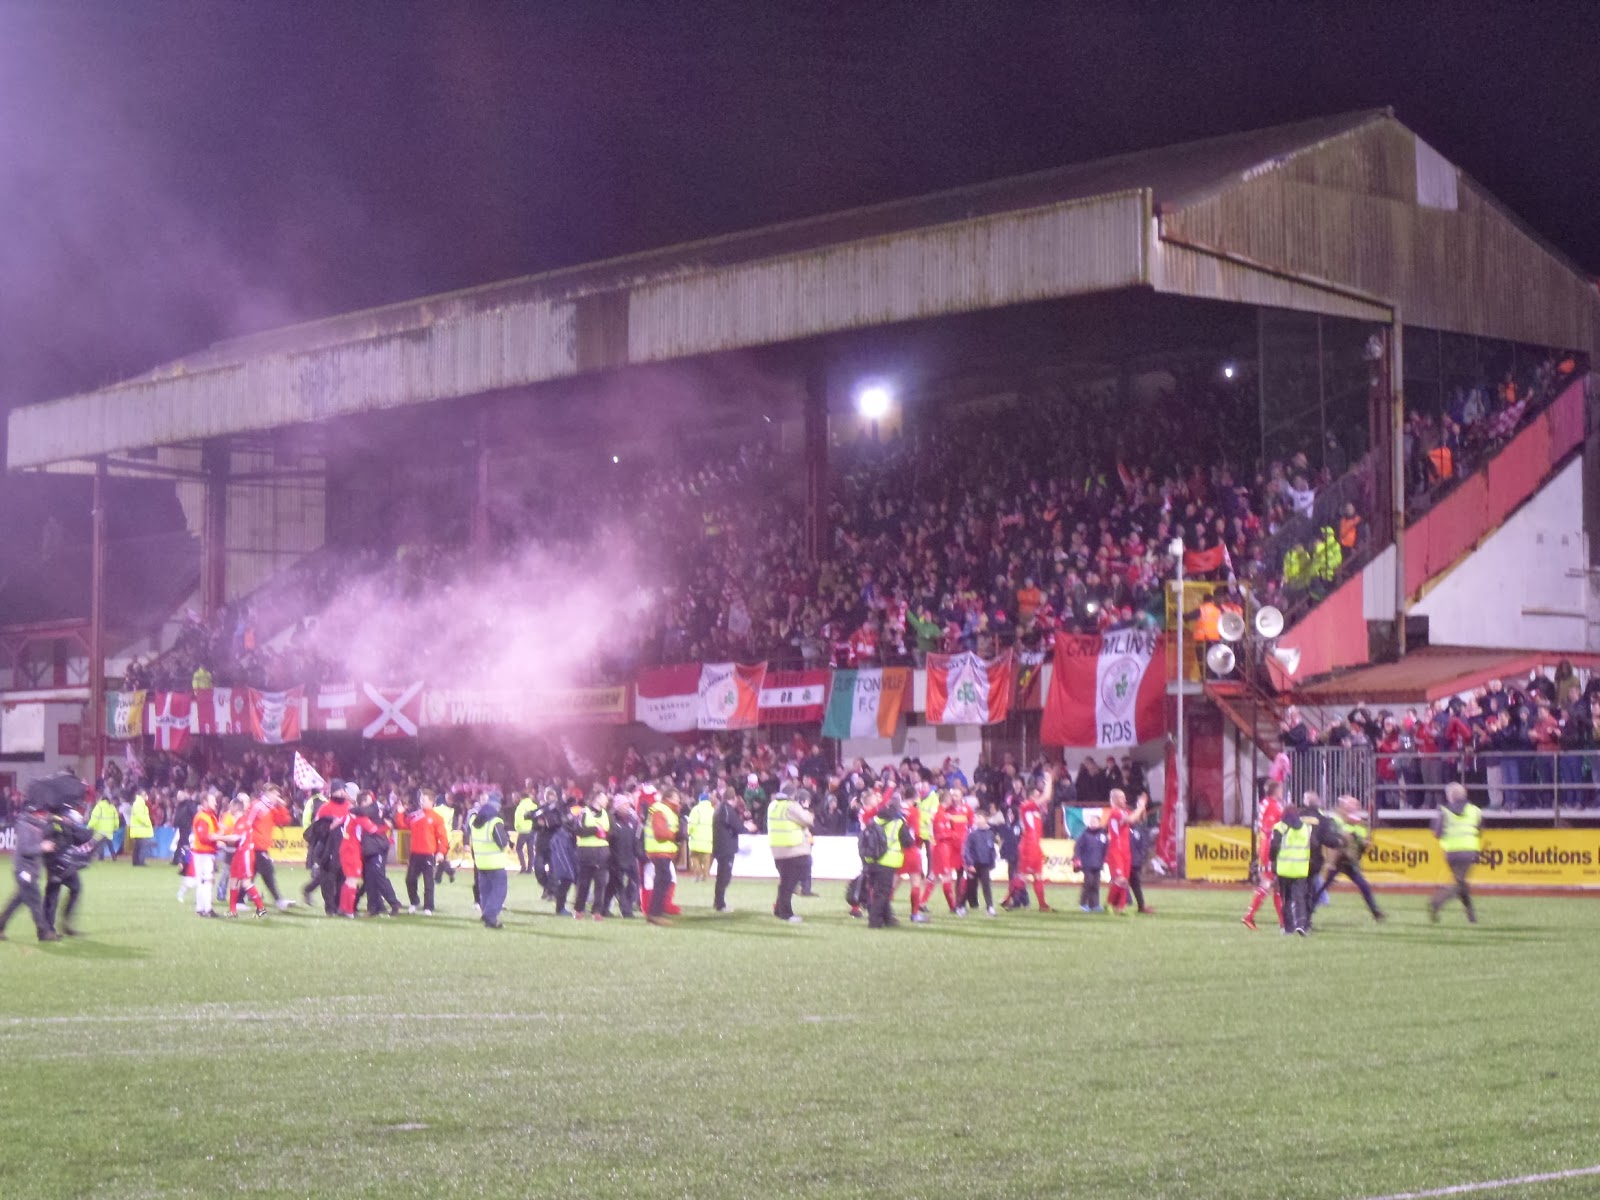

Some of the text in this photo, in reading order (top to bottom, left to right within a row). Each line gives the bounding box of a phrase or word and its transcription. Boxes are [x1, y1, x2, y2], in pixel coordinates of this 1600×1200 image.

[1194, 843, 1250, 861] Mobile
[1368, 845, 1429, 868] design
[1507, 845, 1592, 865] solutions
